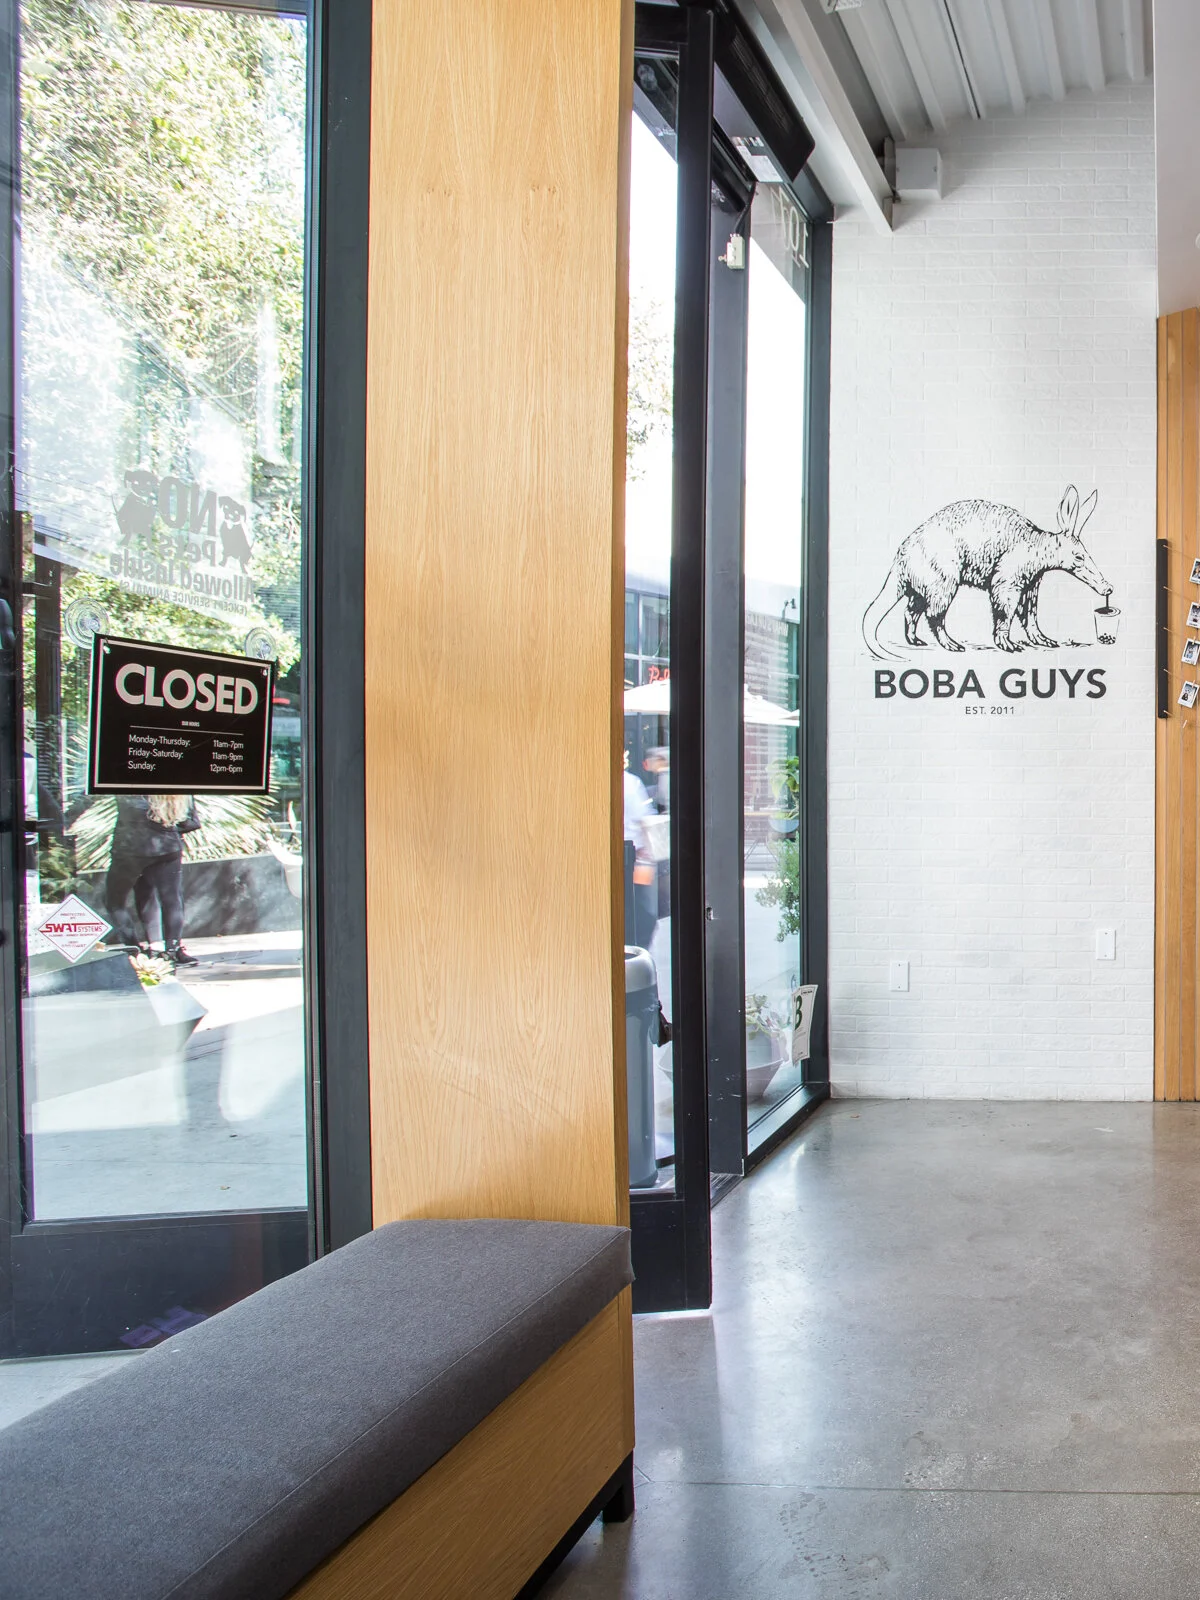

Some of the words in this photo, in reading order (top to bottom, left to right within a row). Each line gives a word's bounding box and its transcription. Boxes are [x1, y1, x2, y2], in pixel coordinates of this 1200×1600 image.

[115, 663, 259, 715] CLOSED
[874, 668, 986, 698] BOBA
[1000, 667, 1107, 699] GUYS
[965, 706, 986, 715] EST.
[990, 706, 1015, 715] 2011
[129, 734, 191, 746] Monday-Thursday:
[213, 740, 244, 749] 11am-7pm
[128, 747, 184, 759] Friday-Saturday:
[212, 752, 243, 762] 11am-9pm
[128, 761, 156, 771] Sunday:
[210, 763, 242, 774] 12pm-6pm
[41, 923, 77, 933] SWAT
[77, 925, 103, 933] SYSTEMS
